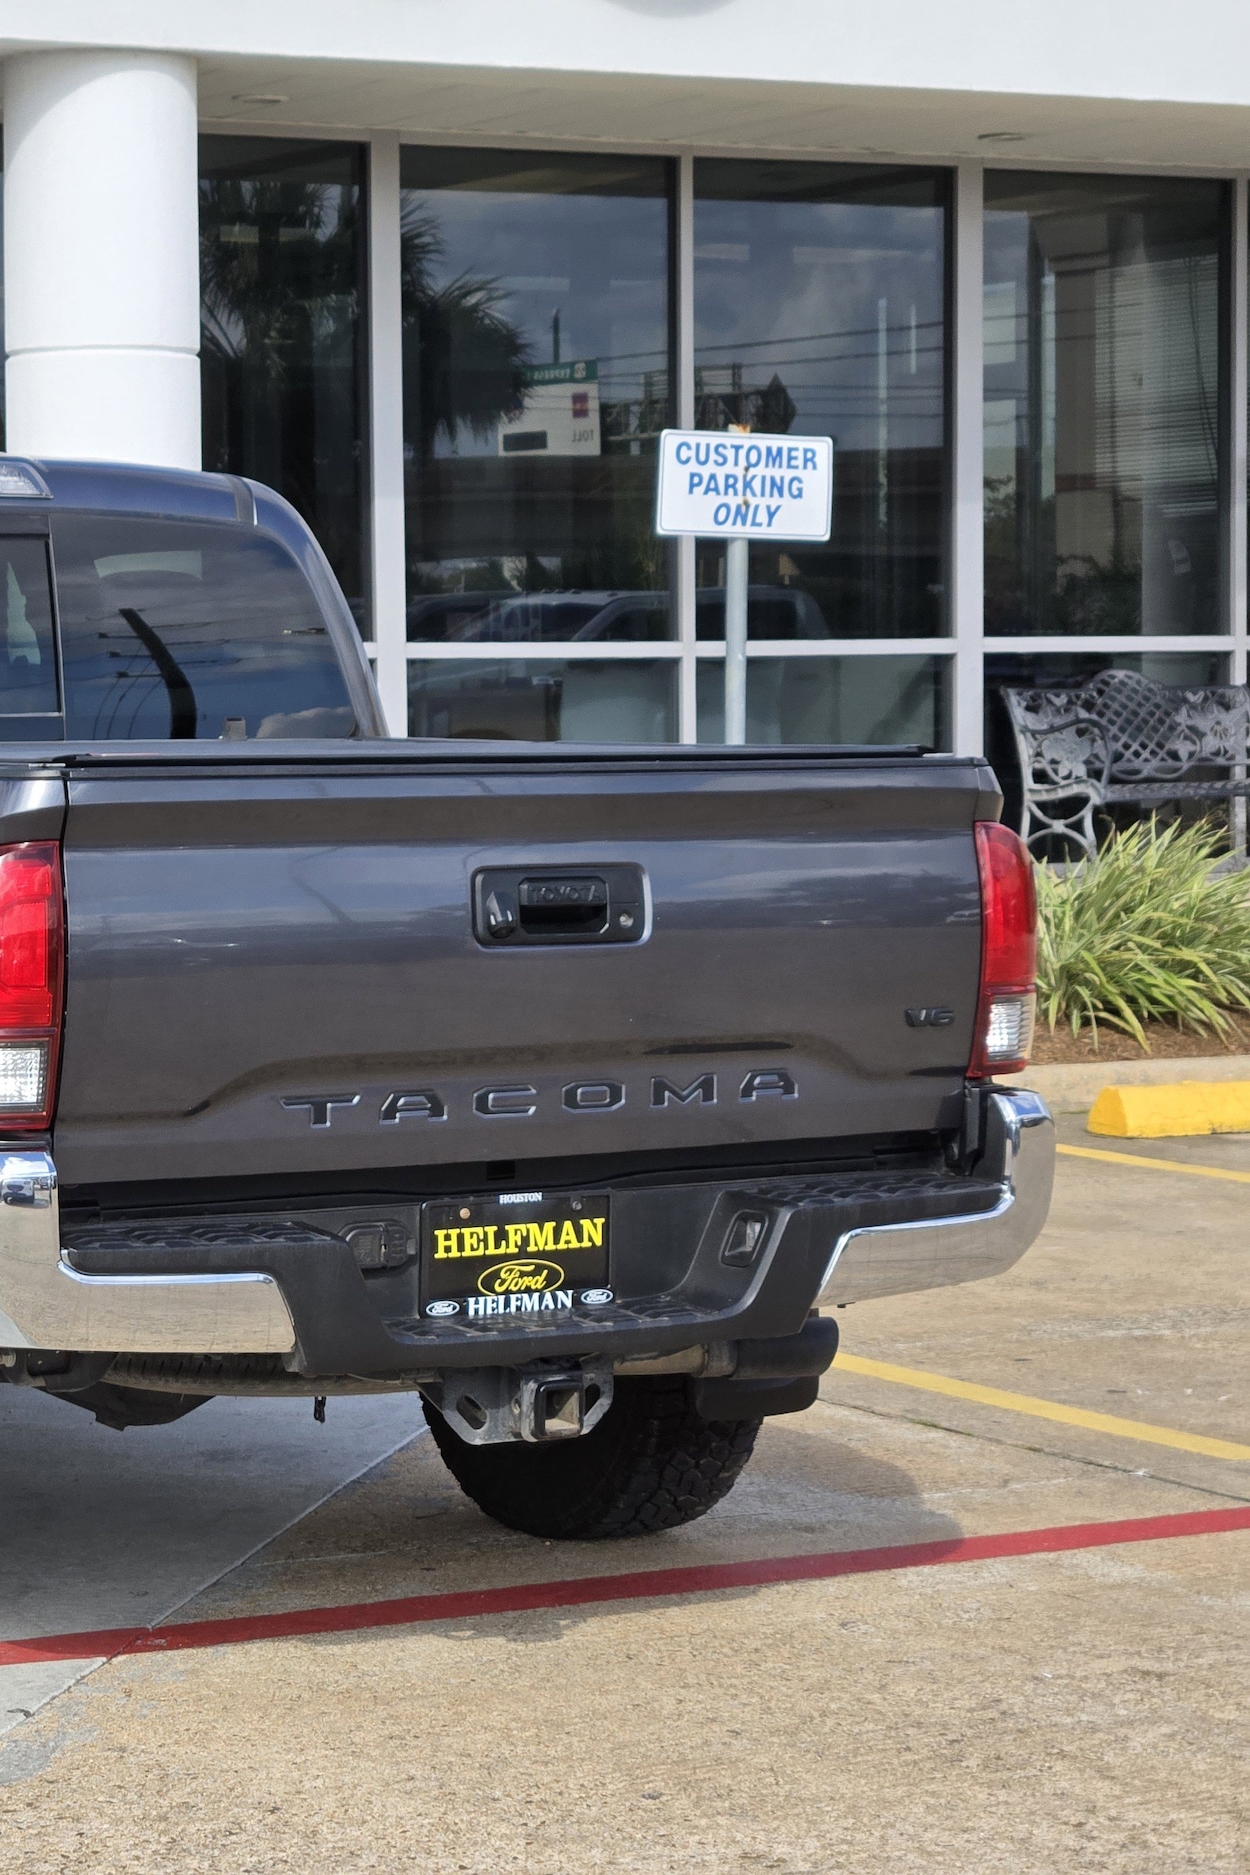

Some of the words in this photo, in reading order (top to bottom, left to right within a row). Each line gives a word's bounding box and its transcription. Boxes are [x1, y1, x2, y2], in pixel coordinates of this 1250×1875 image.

[675, 441, 818, 470] CUSTOMER
[688, 472, 804, 499] PARKING
[713, 502, 782, 528] ONLY
[904, 1007, 954, 1028] V6
[280, 1068, 798, 1128] TACOMA
[499, 1192, 542, 1204] HOUSTON
[433, 1217, 606, 1260] HELFMAN
[494, 1264, 548, 1292] Ford
[467, 1289, 574, 1317] HELFMAN
